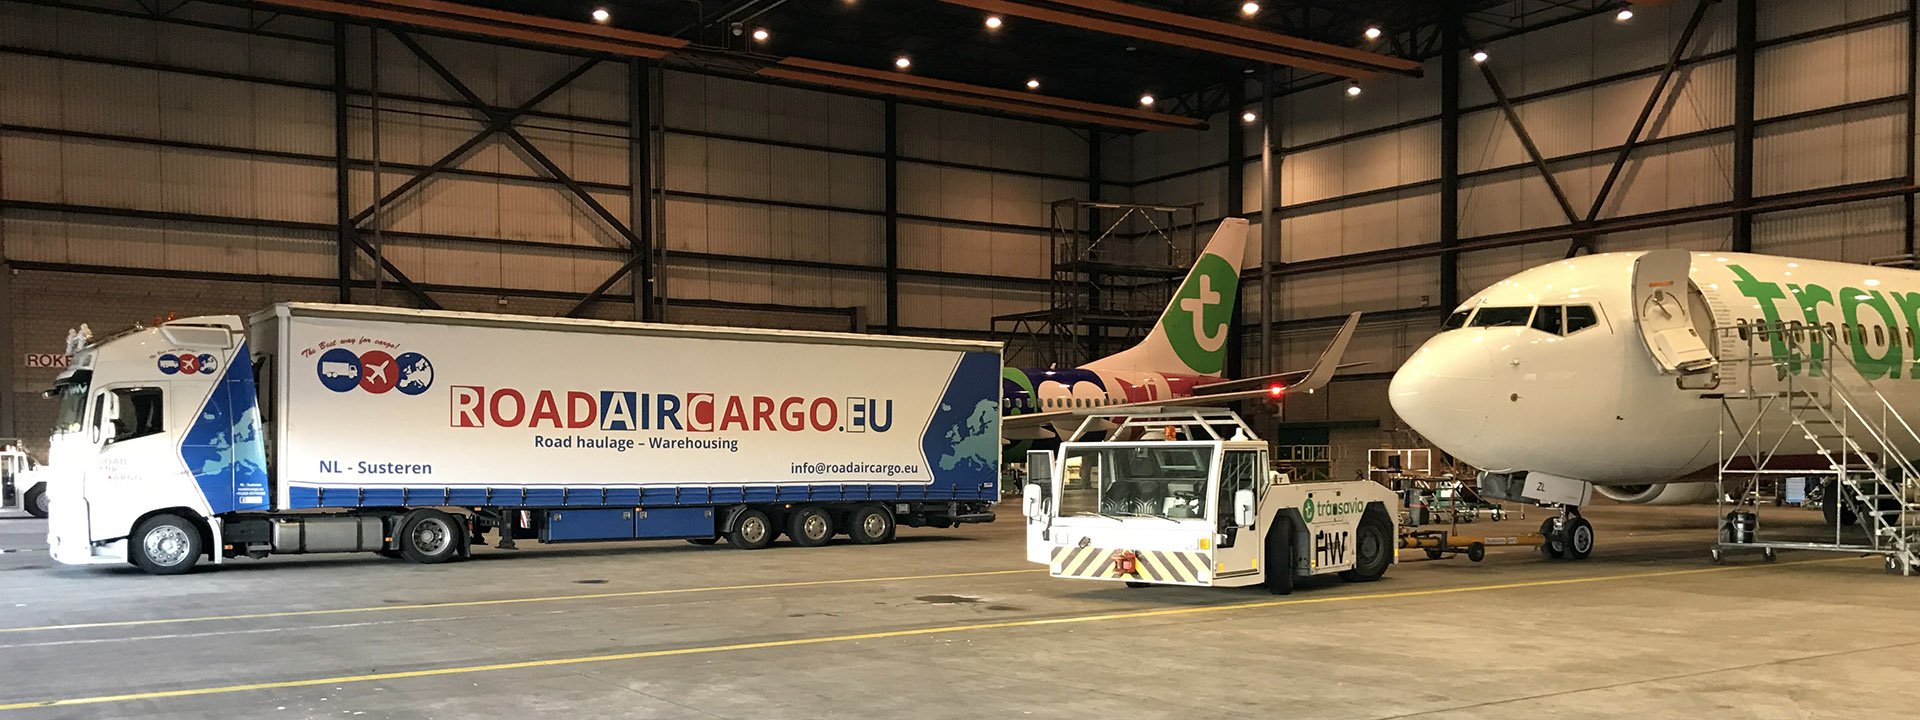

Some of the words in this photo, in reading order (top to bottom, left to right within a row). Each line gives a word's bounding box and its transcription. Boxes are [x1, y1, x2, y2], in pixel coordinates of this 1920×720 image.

[301, 347, 316, 358] The
[319, 340, 337, 350] Best
[359, 336, 371, 345] for
[374, 339, 400, 350] cargo!
[535, 435, 572, 448] Road
[576, 436, 635, 452] haulage
[648, 437, 739, 452] Warehousing
[319, 460, 342, 473] NL
[358, 461, 432, 474] Susteren
[791, 461, 919, 477] info@roadaircargo.eu
[1536, 481, 1545, 492] ZL
[1317, 500, 1364, 516] trasavia
[1315, 532, 1348, 567] HW
